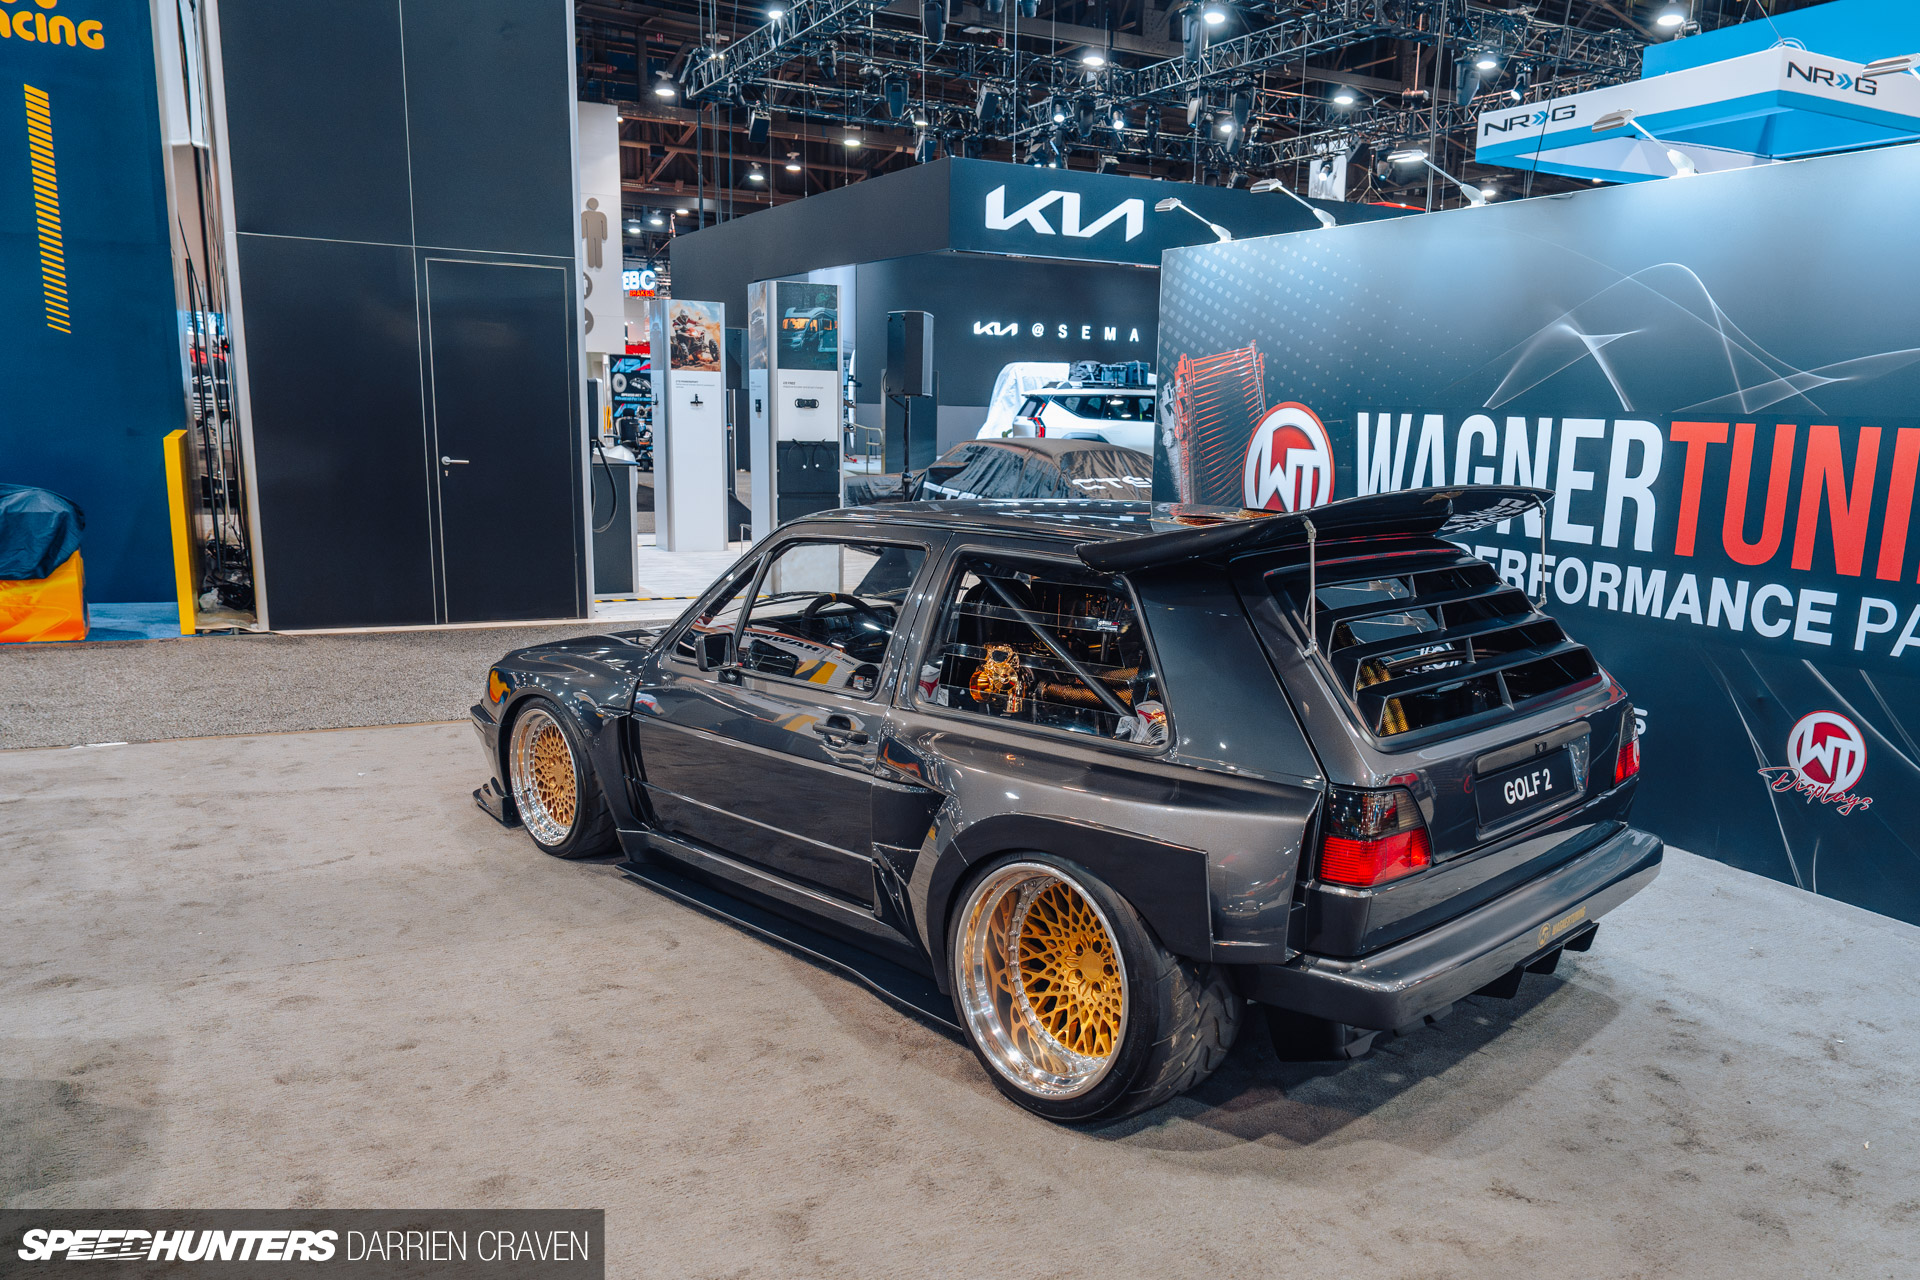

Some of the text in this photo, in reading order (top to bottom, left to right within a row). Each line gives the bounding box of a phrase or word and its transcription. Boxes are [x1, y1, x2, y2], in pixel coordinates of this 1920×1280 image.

[622, 270, 656, 290] EBC
[1031, 322, 1045, 338] @
[1057, 323, 1140, 342] SEMA
[1356, 410, 1920, 585] WAGNERTUNI
[1504, 768, 1553, 805] GOLF 2
[1757, 766, 1874, 816] Displays
